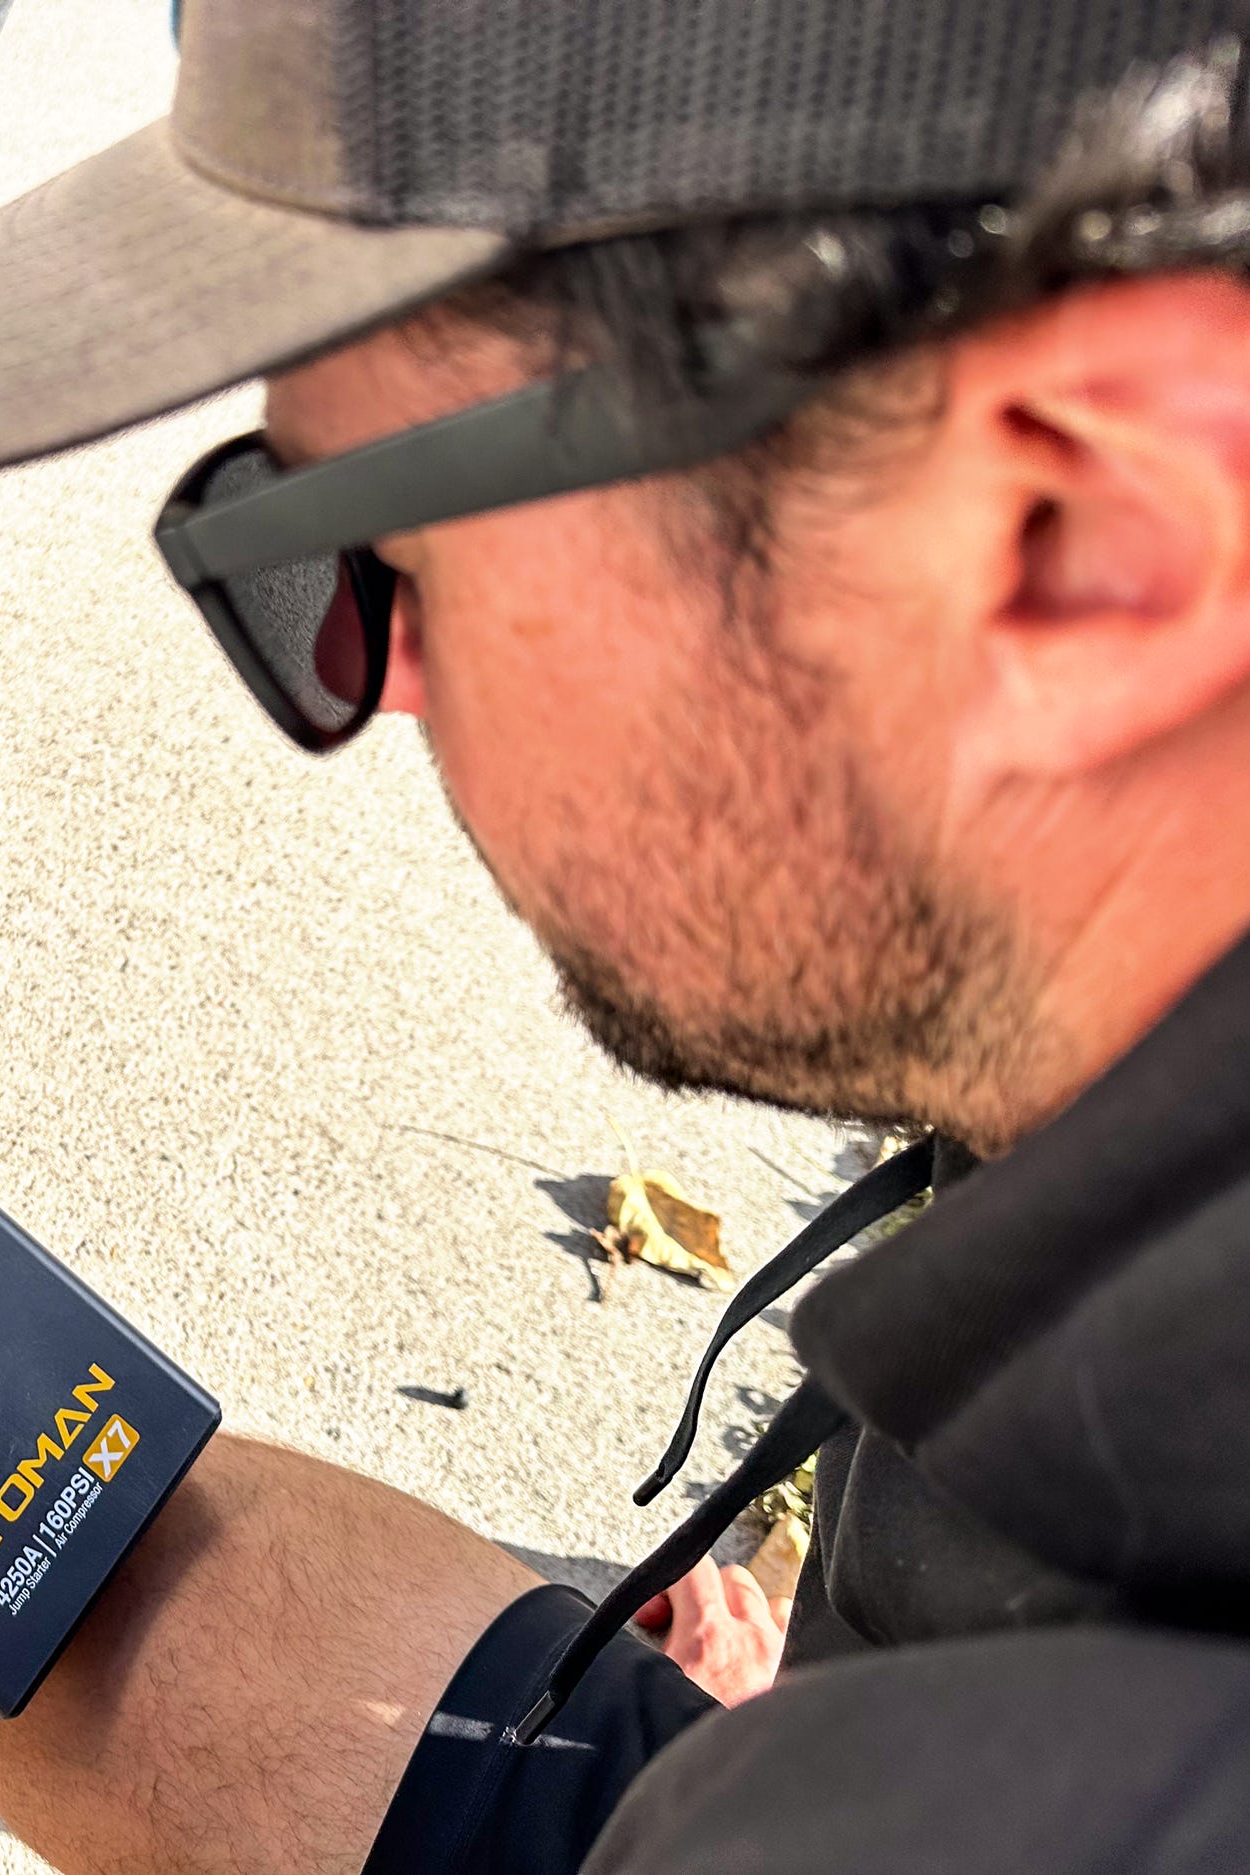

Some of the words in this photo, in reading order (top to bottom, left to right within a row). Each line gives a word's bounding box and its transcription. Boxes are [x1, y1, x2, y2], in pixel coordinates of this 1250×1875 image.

[88, 1419, 131, 1480] X7
[39, 1467, 95, 1540] 160PSI
[54, 1532, 68, 1550] Air
[63, 1482, 104, 1536] Compressor
[8, 1587, 31, 1616] Jump
[26, 1556, 52, 1590] Starter
